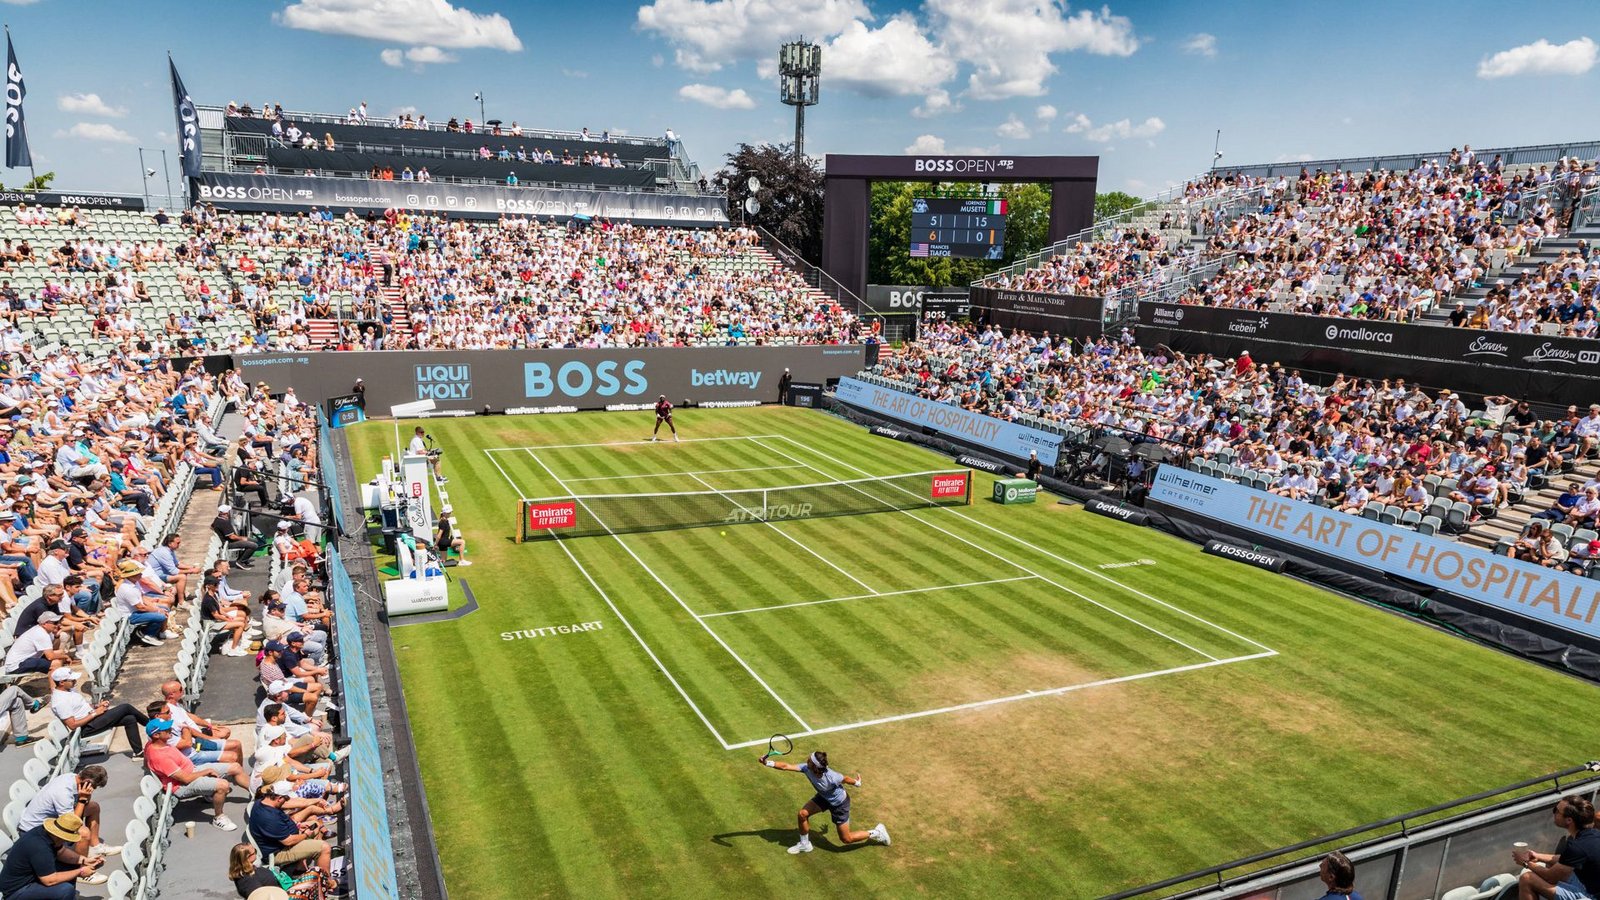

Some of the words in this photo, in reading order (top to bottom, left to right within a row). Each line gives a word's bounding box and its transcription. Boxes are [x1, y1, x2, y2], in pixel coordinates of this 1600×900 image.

[335, 194, 391, 204] bossopen.com
[930, 216, 937, 226] 5
[976, 216, 988, 227] 15
[929, 230, 936, 240] 6
[976, 232, 983, 242] 0
[1018, 294, 1026, 302] &
[1154, 308, 1174, 318] Allianz
[1229, 322, 1256, 334] icebein
[1339, 328, 1393, 344] mallorca
[242, 357, 294, 366] bossopen.com
[416, 366, 468, 382] LIQUI
[524, 360, 648, 398] BOSS
[692, 368, 762, 389] betway
[418, 383, 470, 400] MOLY
[872, 390, 890, 408] THE
[889, 396, 910, 415] ART
[910, 401, 925, 420] OF
[927, 406, 1001, 441] HOSPITALITY
[877, 427, 900, 438] betway
[934, 479, 964, 488] Emirates
[1160, 472, 1218, 495] wilhelmer
[532, 508, 574, 518] Emirates
[767, 502, 812, 520] TOUR
[1096, 502, 1134, 519] betway
[538, 518, 548, 526] FLY
[548, 516, 568, 524] BETTER
[1247, 496, 1292, 530] THE
[1292, 511, 1353, 550] ART
[1356, 528, 1403, 562] OF
[500, 620, 604, 641] STUTTGART
